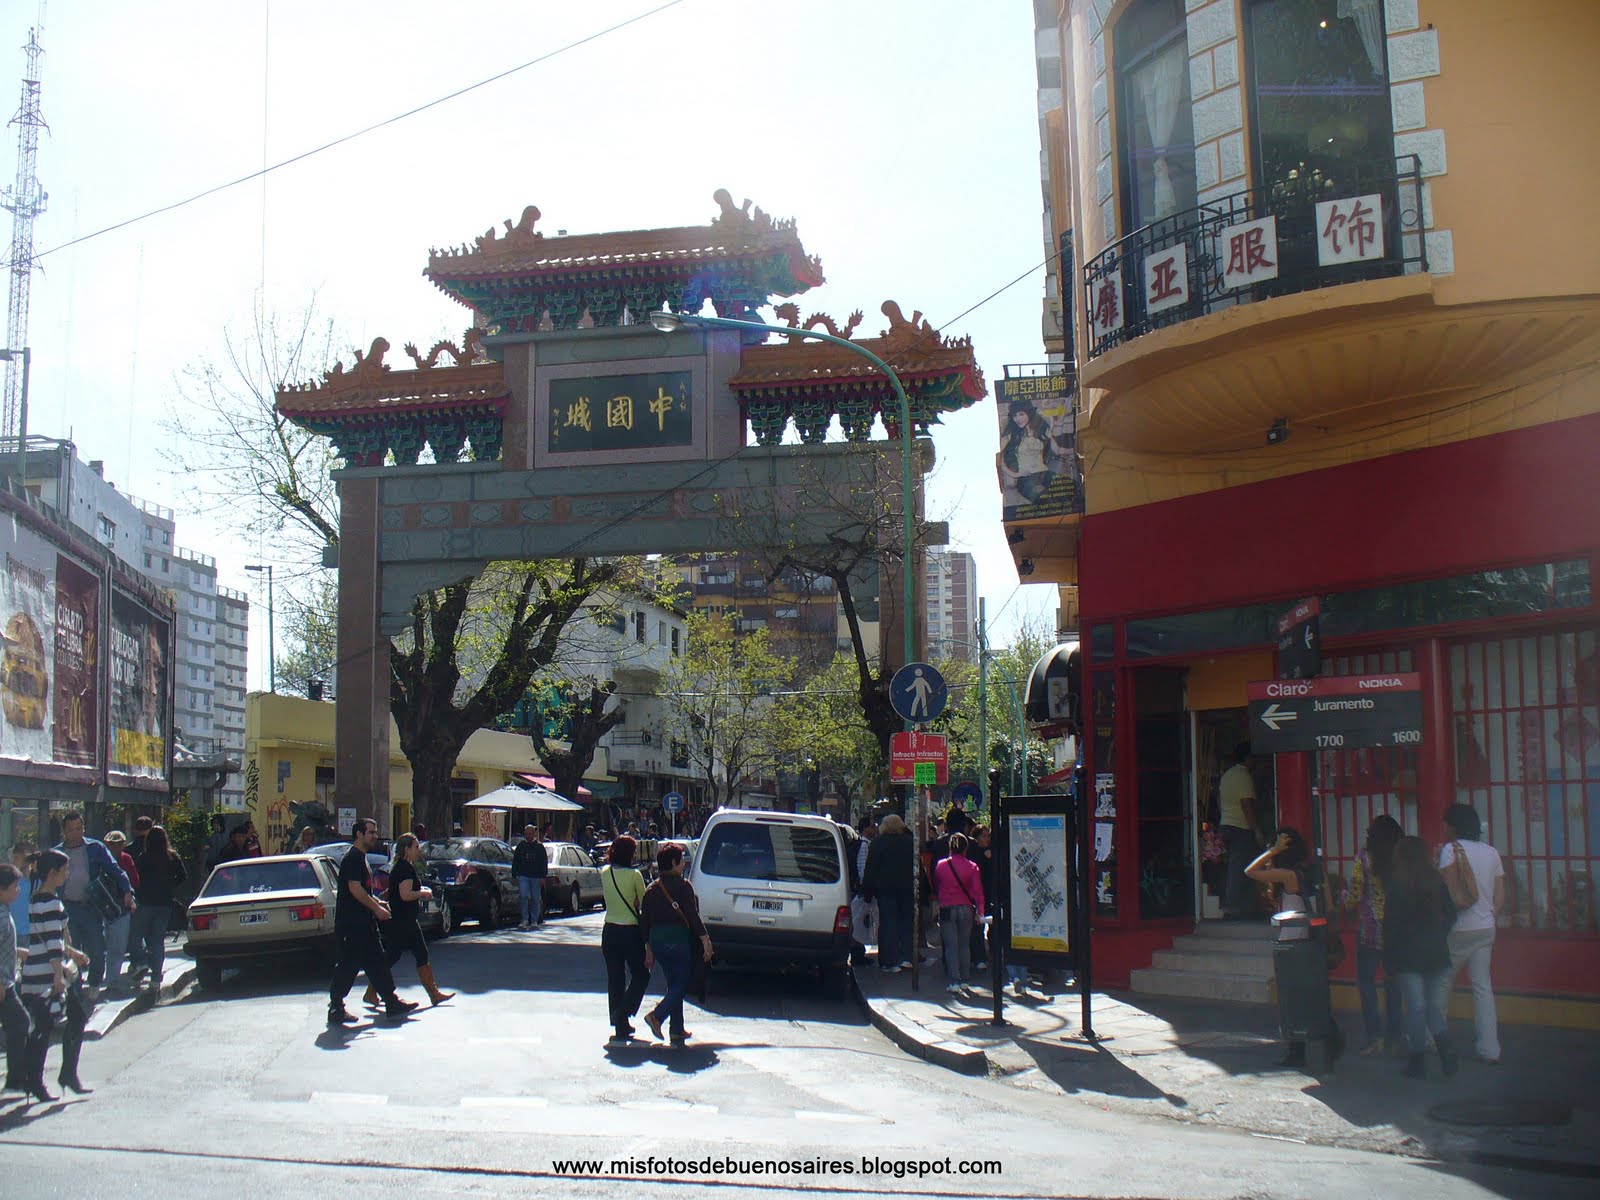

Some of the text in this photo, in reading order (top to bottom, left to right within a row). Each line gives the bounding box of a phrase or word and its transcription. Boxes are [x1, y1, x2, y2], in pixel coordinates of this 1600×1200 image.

[58, 604, 83, 635] CUARTO
[66, 630, 83, 656] LIBRA
[1266, 678, 1403, 697] Claro NOKIA
[1313, 698, 1375, 712] Juramento
[1315, 730, 1421, 748] 1700 1600
[669, 797, 678, 809] E
